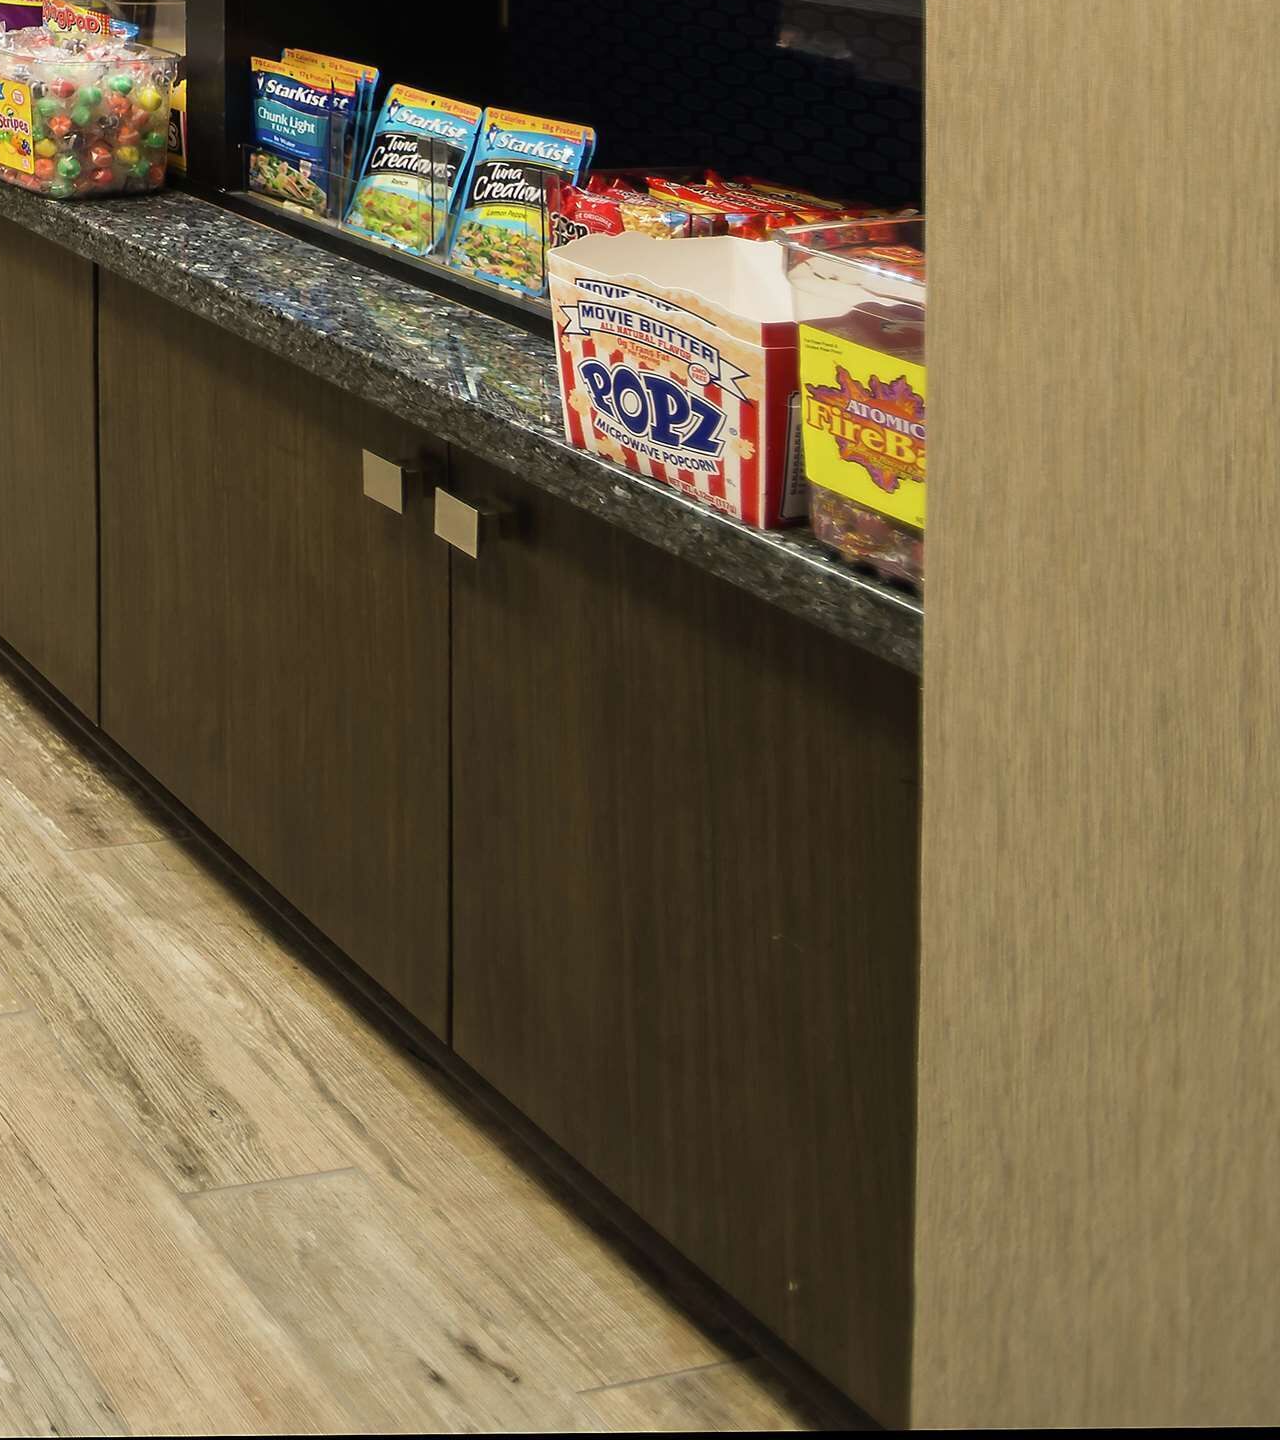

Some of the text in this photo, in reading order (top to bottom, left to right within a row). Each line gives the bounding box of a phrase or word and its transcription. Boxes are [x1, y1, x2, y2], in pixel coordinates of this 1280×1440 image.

[265, 79, 328, 109] StarKist
[405, 90, 428, 105] Calories
[452, 104, 476, 117] Protein
[258, 107, 315, 134] Chunk Light
[272, 123, 296, 136] TUNA
[396, 110, 468, 140] StarKist
[500, 113, 525, 126] Calories
[555, 124, 581, 137] Protein
[386, 134, 418, 152] Tuna
[497, 134, 576, 164] StarKist
[371, 147, 456, 178] Creations
[488, 162, 523, 180] Tuna
[474, 176, 547, 202] Creation
[486, 209, 508, 218] Lemon
[582, 304, 634, 327] MOVIE
[640, 318, 715, 363] BUTTER
[600, 321, 692, 361] ALL NATURAL FLAVOR
[580, 361, 726, 457] POPZ
[846, 399, 926, 440] ATOMIC
[596, 418, 717, 473] MICROWAVE POPCORN
